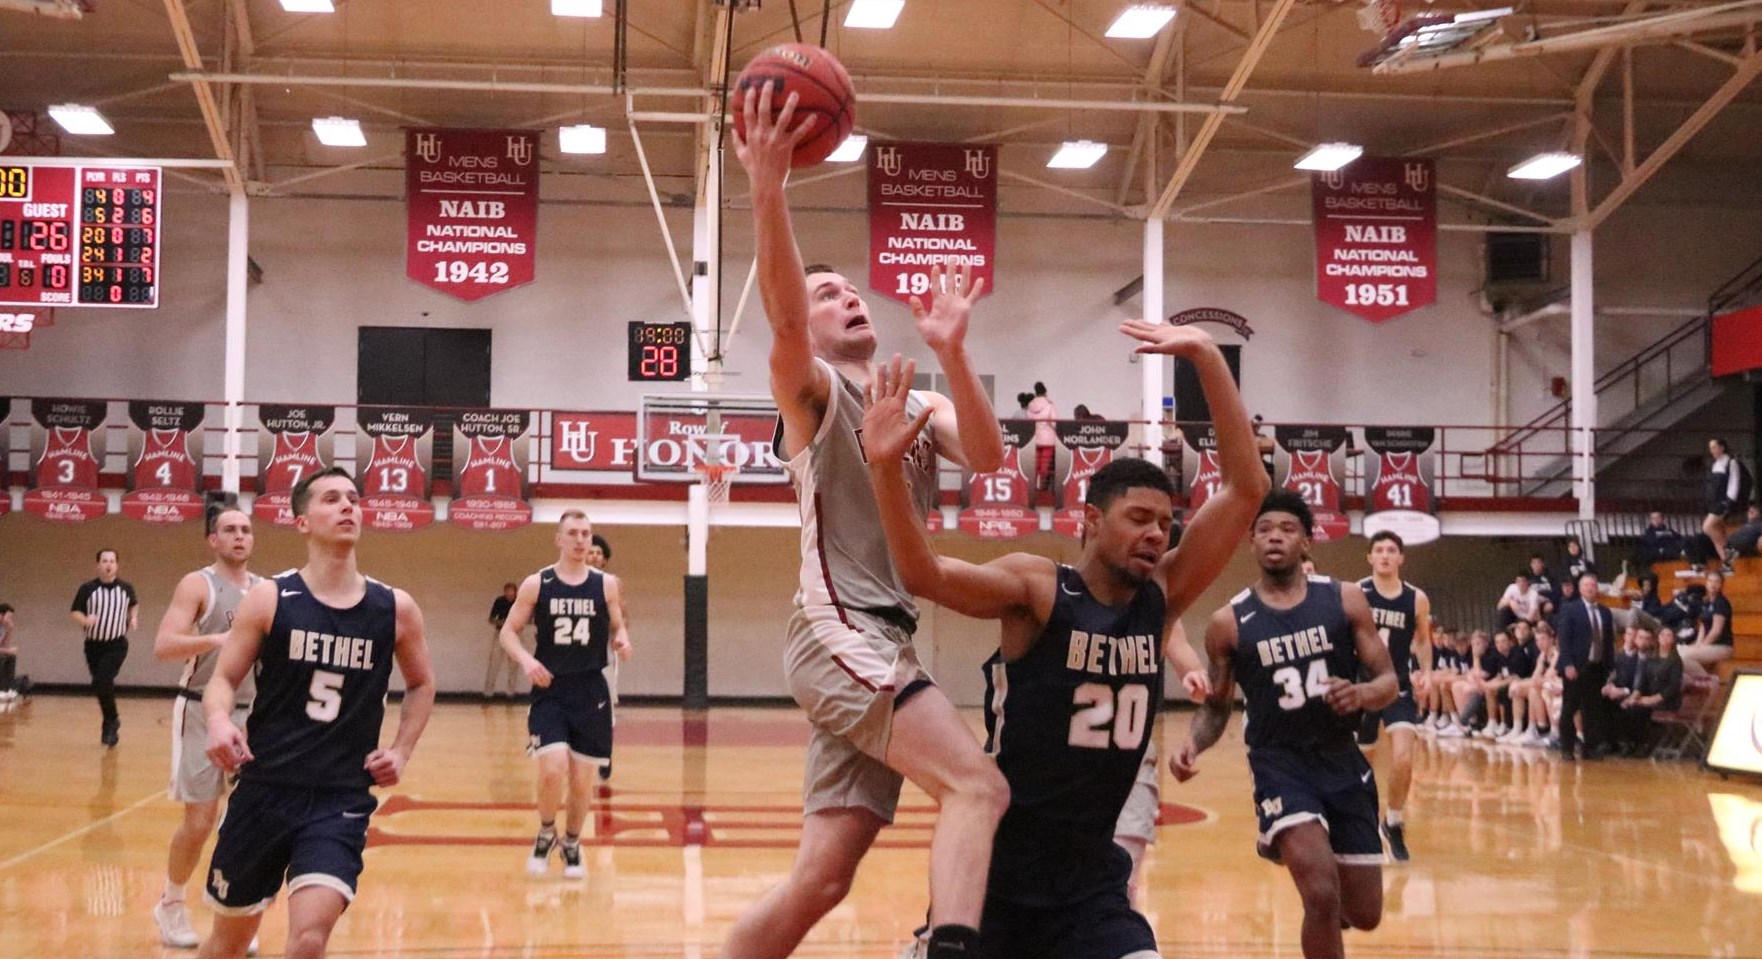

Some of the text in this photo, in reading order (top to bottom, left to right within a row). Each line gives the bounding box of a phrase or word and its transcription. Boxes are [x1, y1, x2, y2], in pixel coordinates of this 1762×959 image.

[416, 133, 442, 163] HU
[506, 136, 533, 166] HU
[449, 156, 498, 168] MENS
[876, 147, 902, 176] HU
[965, 150, 991, 179] HU
[135, 173, 151, 183] PTS
[420, 171, 526, 185] BASKETBALL
[908, 169, 957, 182] MENS
[1404, 163, 1428, 192] HU
[881, 184, 984, 198] BASKETBALL
[1351, 182, 1398, 195] MENS
[96, 188, 154, 206] 4 0 4
[1325, 197, 1423, 210] BASKETBALL
[22, 203, 68, 218] GUEST
[95, 207, 153, 224] 5 2 6
[439, 200, 506, 218] NAIB
[900, 213, 965, 231] NAIB
[30, 221, 68, 250] 26
[82, 227, 153, 244] 20 0 7
[426, 225, 518, 238] NATIONAL
[1344, 225, 1407, 243] NAIB
[417, 240, 526, 254] CHAMPIONS
[888, 237, 977, 250] NATIONAL
[41, 254, 71, 264] FOULS
[82, 246, 105, 262] 24
[140, 246, 153, 263] 2
[879, 253, 985, 266] CHAMPIONS
[1334, 249, 1418, 262] NATIONAL
[51, 265, 66, 288] 0
[82, 267, 104, 283] 34
[142, 267, 152, 283] 7
[434, 261, 510, 284] 1942
[1326, 264, 1427, 278] CHAMPIONS
[41, 292, 71, 302] SCORE
[110, 285, 122, 302] 0
[1345, 284, 1408, 305] 1951
[1172, 309, 1244, 329] CONCESSIONS
[641, 345, 677, 376] 28
[52, 404, 87, 413] HOWIE
[148, 406, 184, 416] ROLLIE
[287, 409, 306, 419] JOE
[47, 414, 91, 424] SCHULTZ
[152, 417, 181, 426] SELTZ
[381, 412, 409, 422] VERN
[463, 413, 520, 424] COACH JOE
[367, 423, 423, 433] MIKKELSEN
[1079, 425, 1106, 434] JOHN
[559, 420, 598, 462] HU
[1063, 435, 1120, 444] NORLANDER
[1287, 439, 1332, 448] FRITSCHE
[48, 448, 89, 460] HAMLINE
[145, 450, 186, 462] HAMLINE
[275, 452, 316, 465] HAMLINE
[374, 456, 416, 469] HAMLINE
[470, 457, 511, 470] HAMLINE
[58, 460, 75, 483] 3
[155, 462, 172, 485] 4
[287, 464, 304, 488] 7
[379, 467, 408, 492] 13
[1291, 471, 1330, 483] HAMLINE
[484, 468, 496, 492] 1
[984, 478, 1011, 501] 15
[1299, 482, 1323, 506] 21
[1386, 483, 1412, 506] 41
[49, 503, 81, 513] NBA
[147, 505, 180, 515] NBA
[376, 511, 408, 522] NBA
[550, 598, 596, 615] BETHEL
[1371, 607, 1405, 629] ETHEL
[553, 616, 590, 645] 24
[289, 629, 374, 670] BETHEL
[1066, 629, 1158, 676] BETHEL
[1257, 625, 1333, 668] BETHEL
[1273, 658, 1331, 711] 34
[305, 669, 345, 723] 5
[1068, 682, 1149, 750] 20
